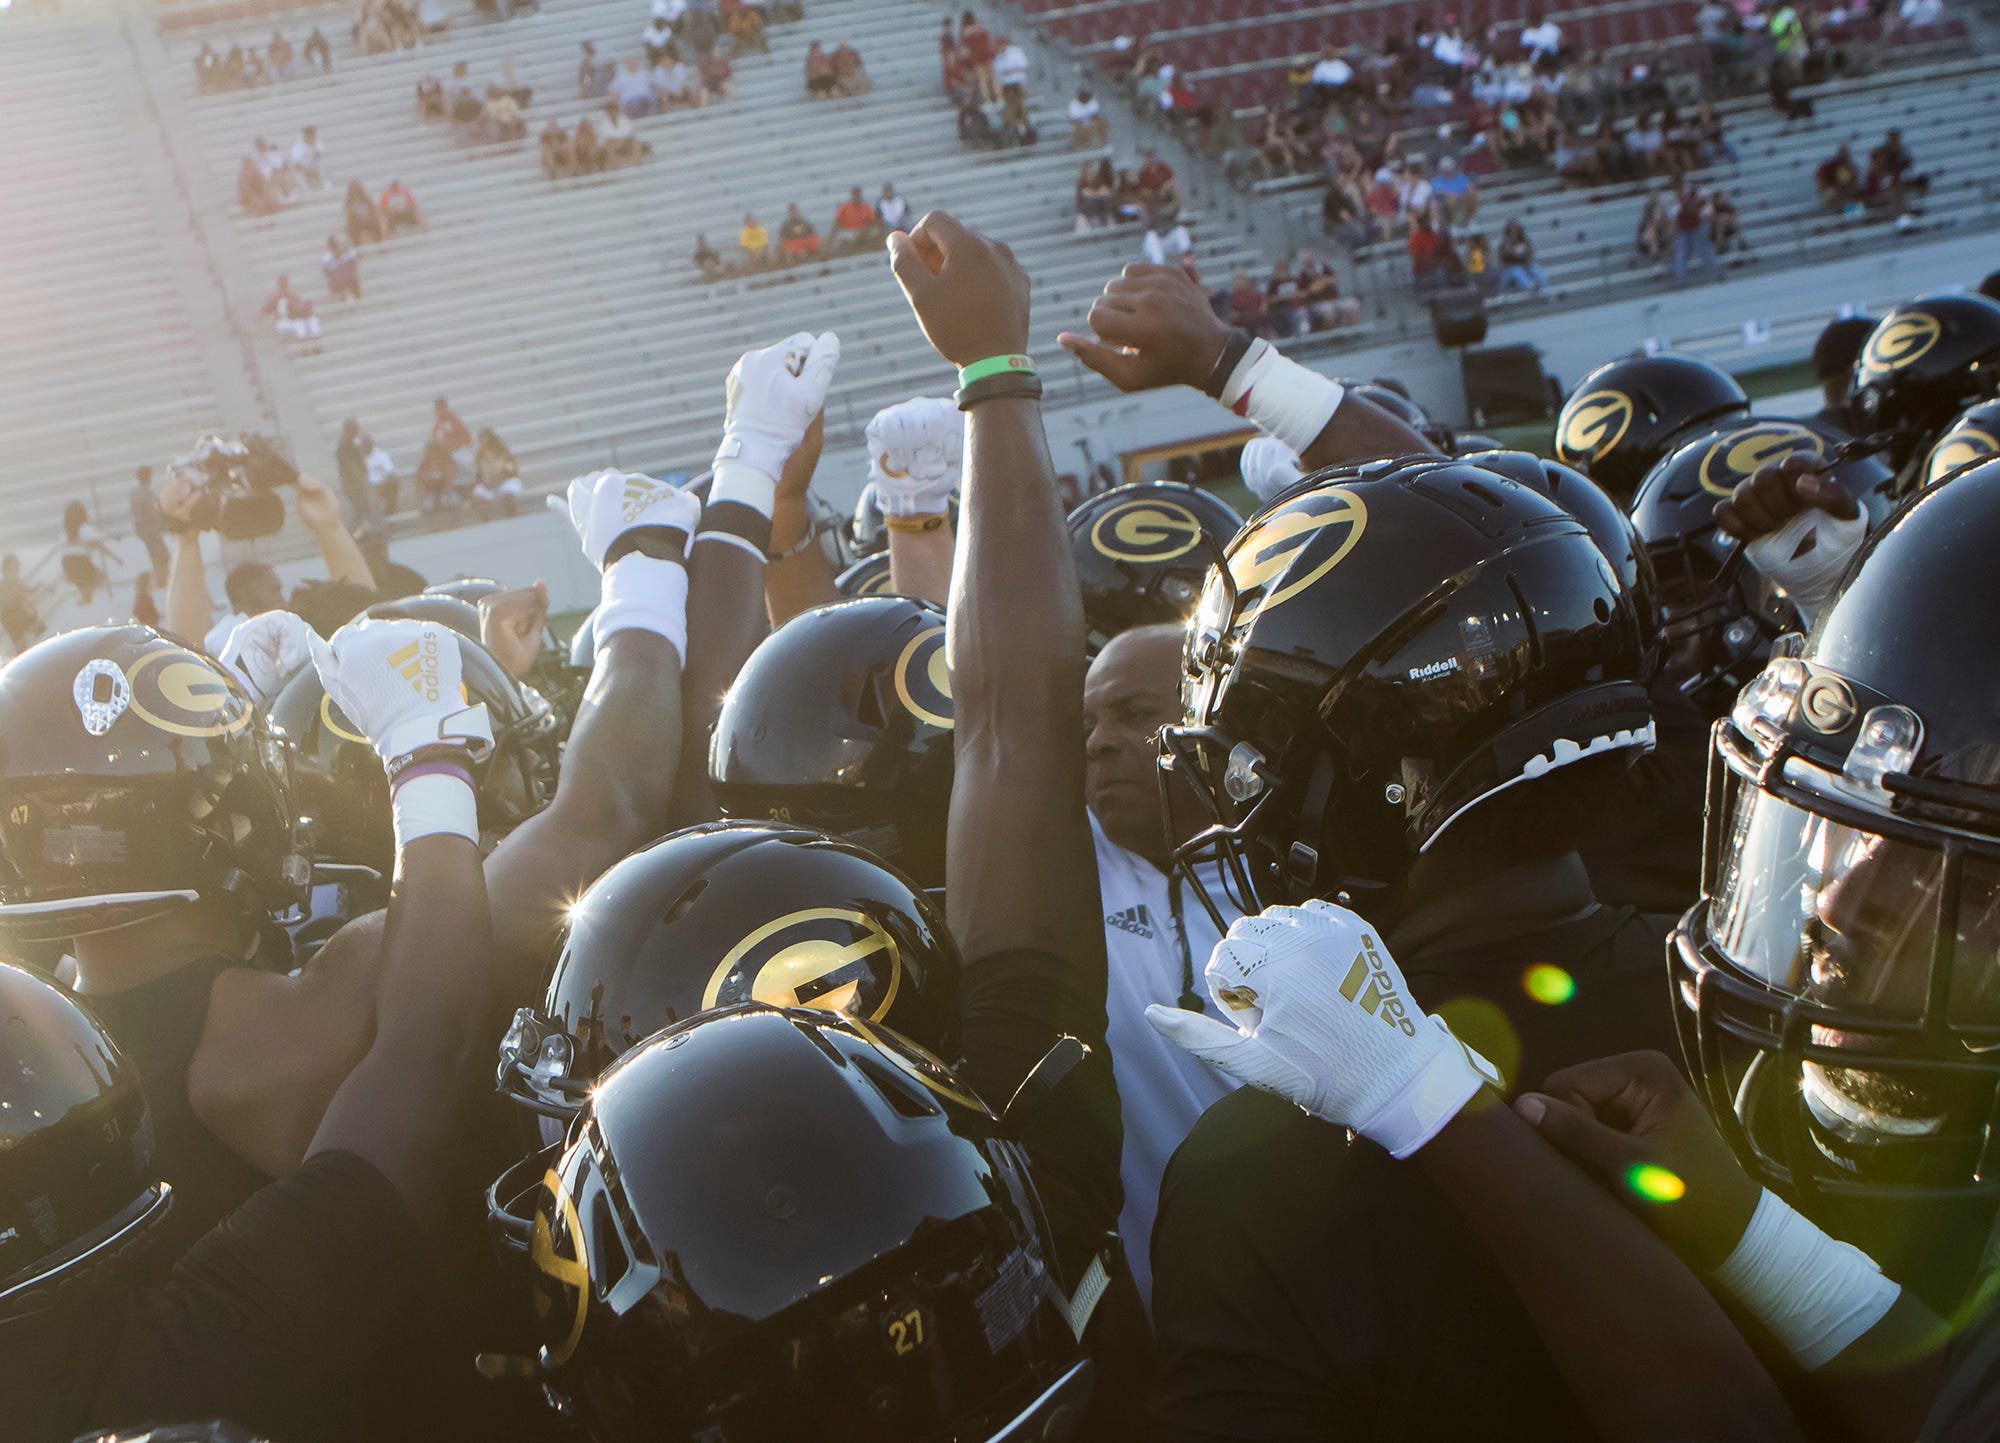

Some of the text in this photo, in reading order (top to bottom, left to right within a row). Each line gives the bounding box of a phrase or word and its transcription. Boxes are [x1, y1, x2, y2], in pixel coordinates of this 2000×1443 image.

[1864, 312, 1941, 373] G
[1555, 390, 1633, 464] G
[1091, 499, 1202, 562] G
[125, 647, 253, 738] G
[424, 631, 440, 703] adidas
[1408, 657, 1458, 680] Riddell
[1801, 675, 1857, 735] G
[11, 804, 29, 825] 47
[1106, 915, 1154, 940] adidas
[1360, 933, 1416, 1038] adidas
[888, 1308, 924, 1356] 27
